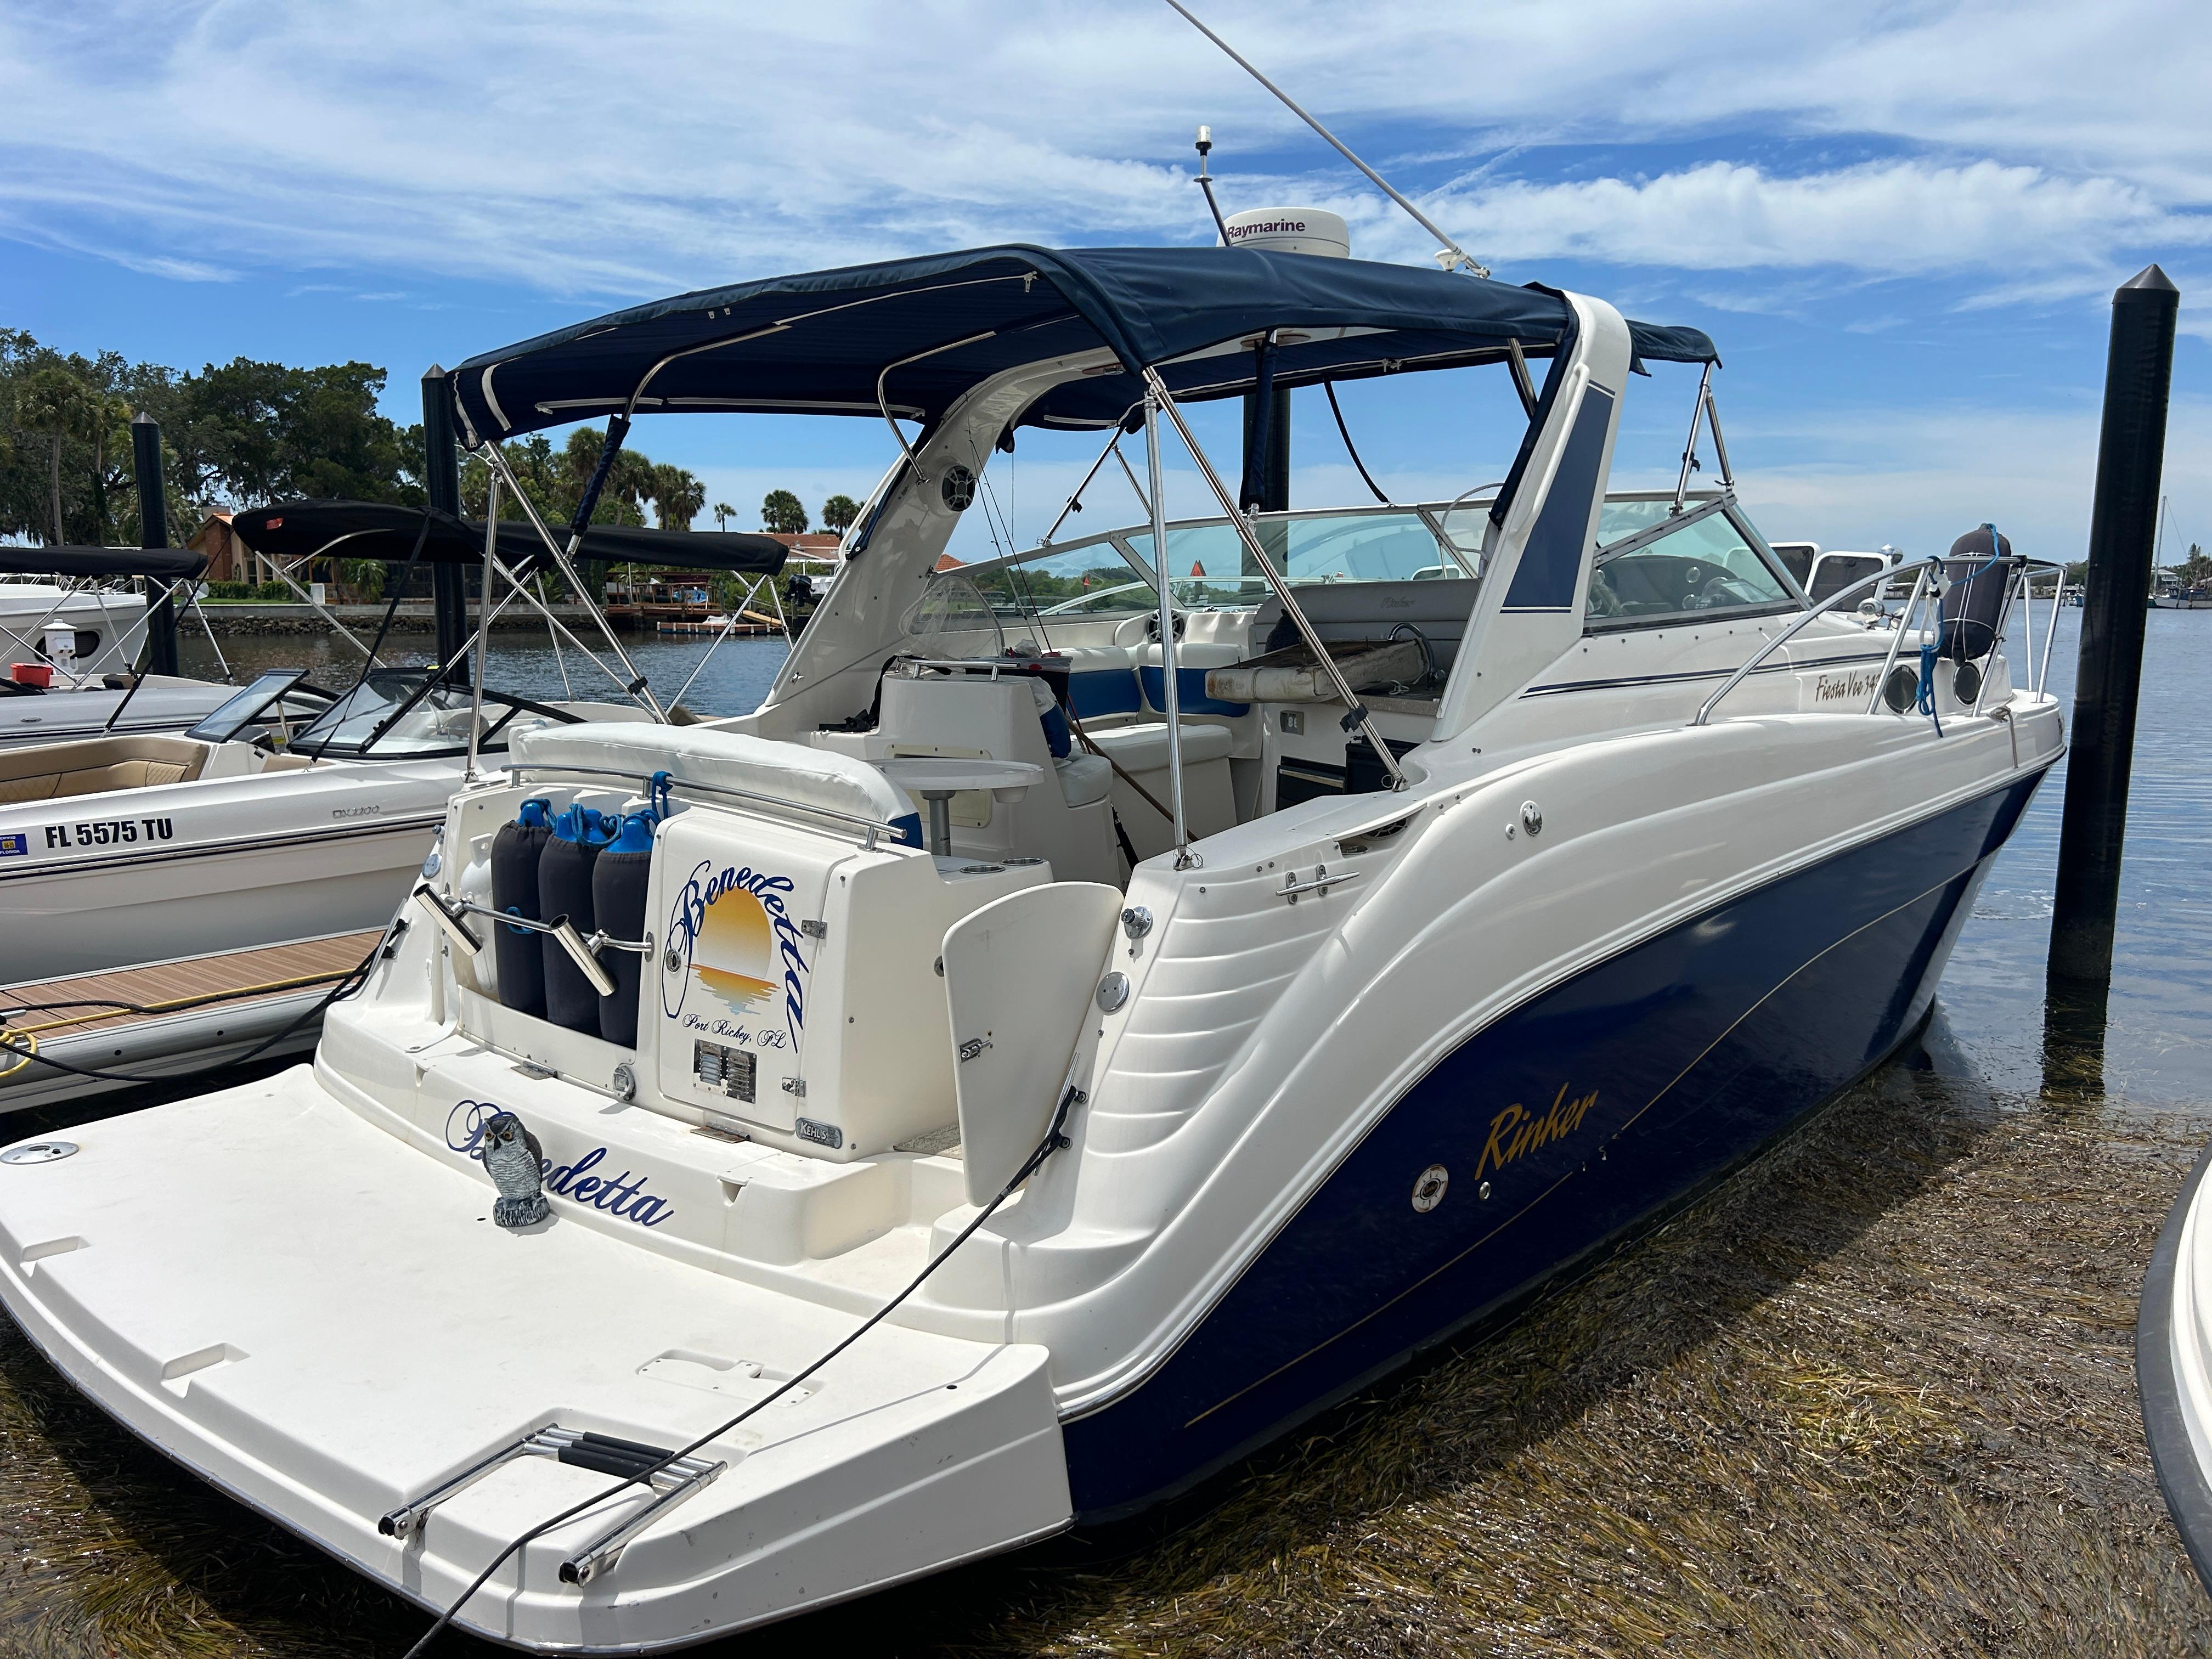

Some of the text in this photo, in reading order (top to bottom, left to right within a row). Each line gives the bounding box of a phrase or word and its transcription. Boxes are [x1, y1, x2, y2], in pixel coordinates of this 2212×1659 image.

[1227, 218, 1306, 239] Raymarine
[1815, 674, 1846, 702] Fiesta
[1847, 670, 1864, 698] Vee
[45, 818, 173, 848] FL 5575 TU
[662, 860, 809, 1054] Benedetta
[682, 1013, 787, 1048] Port Richey, FL
[801, 1121, 827, 1140] KEHL'S
[1475, 1081, 1599, 1181] Rinker
